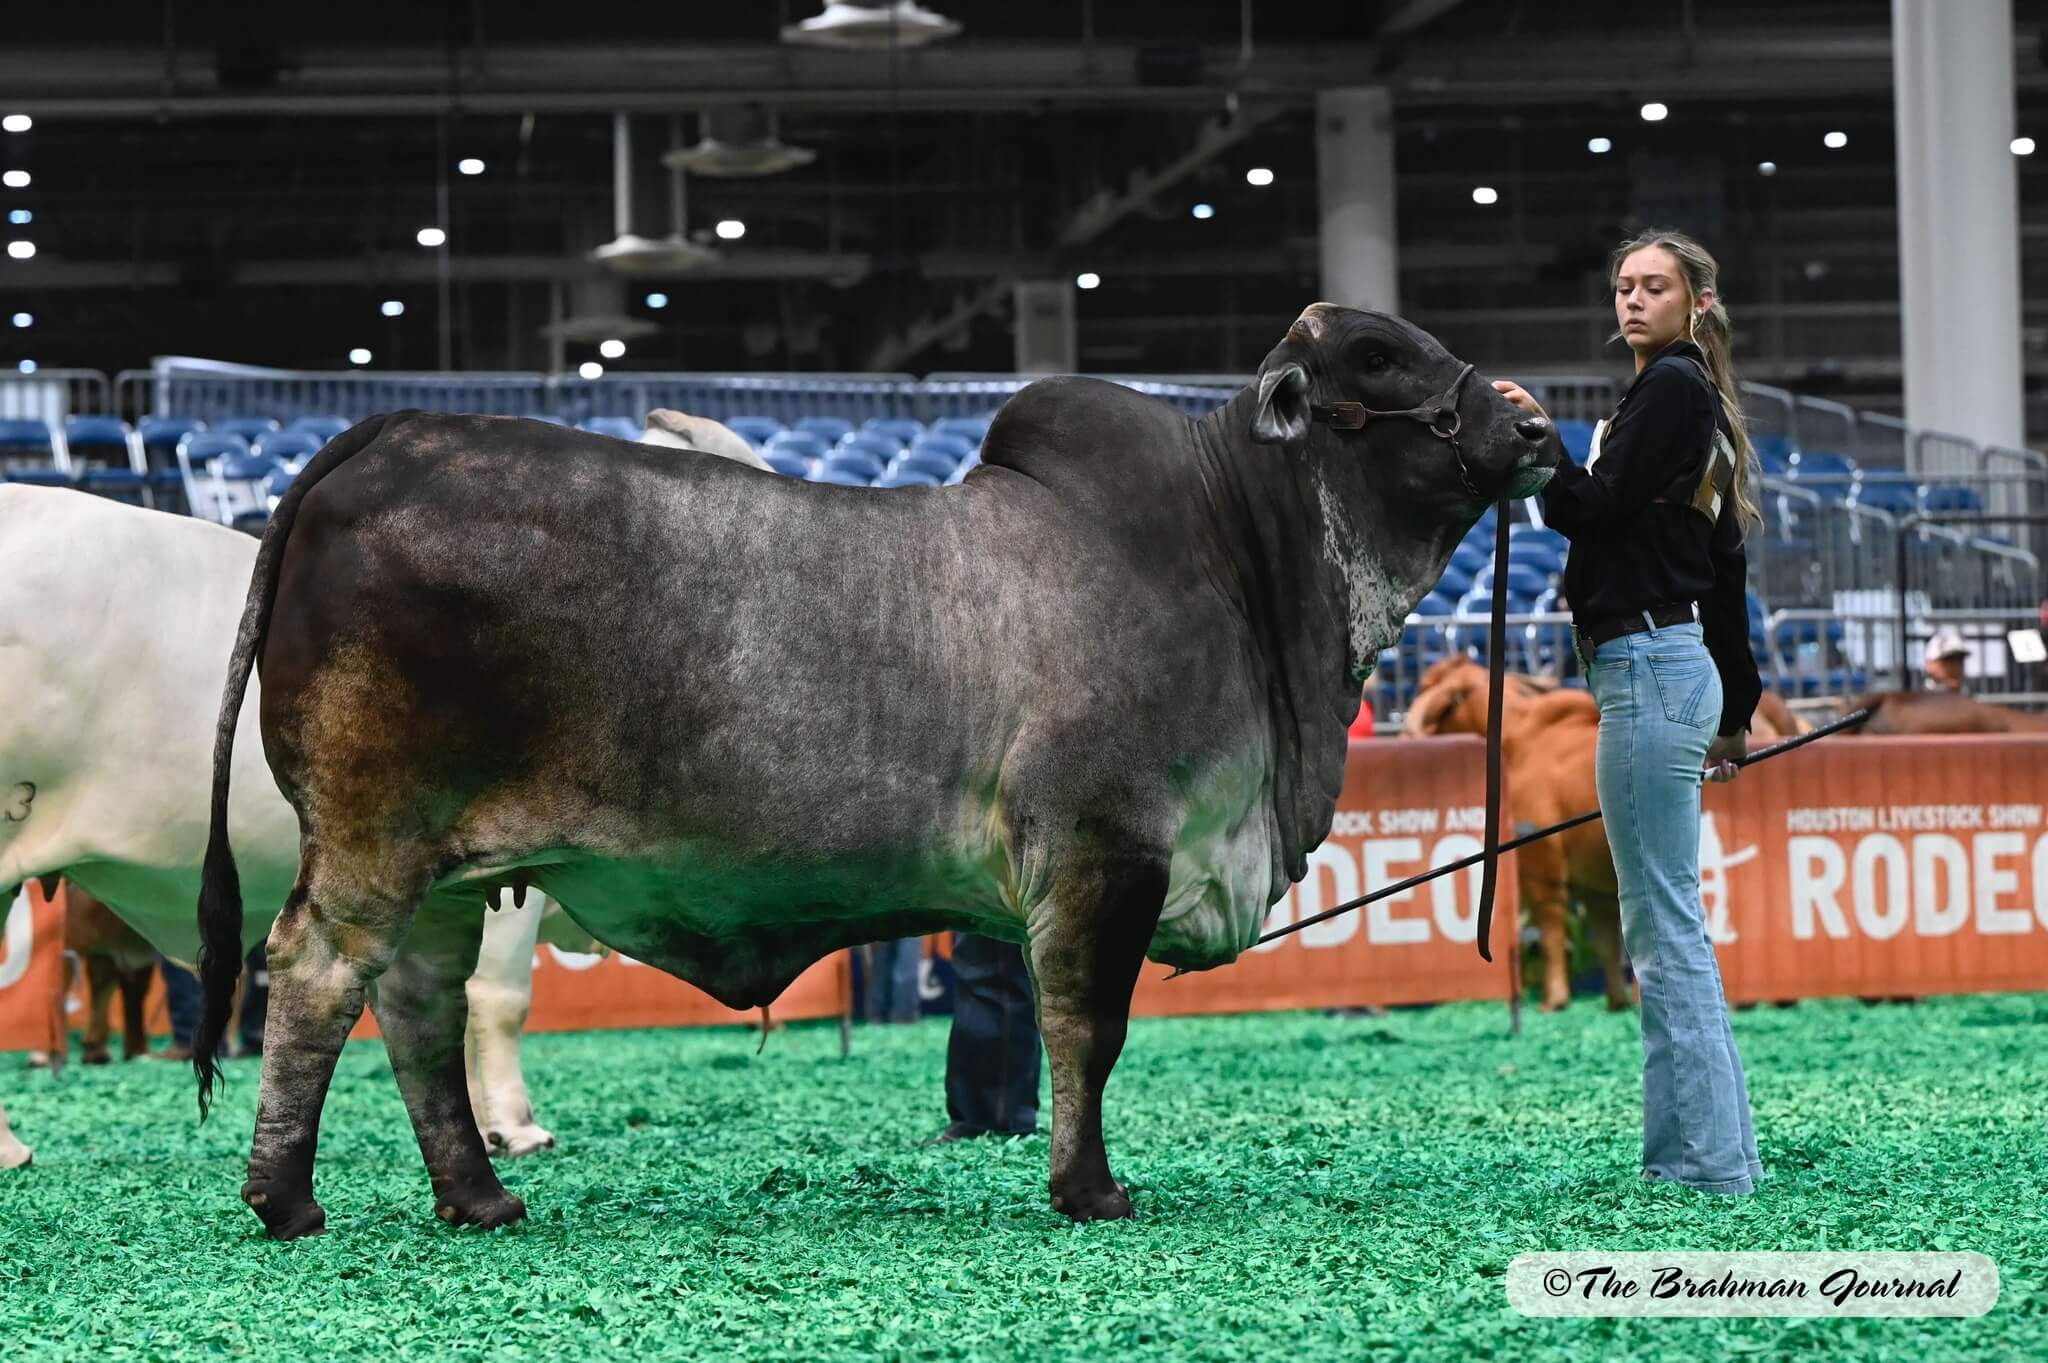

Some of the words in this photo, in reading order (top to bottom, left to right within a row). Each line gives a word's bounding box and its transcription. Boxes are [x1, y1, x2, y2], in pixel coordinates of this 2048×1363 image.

[1378, 808, 1439, 833] SHOW
[1787, 808, 1873, 832] HOUSTON
[1879, 805, 1983, 829] LIVESTOCK
[1988, 803, 2042, 828] SHOW
